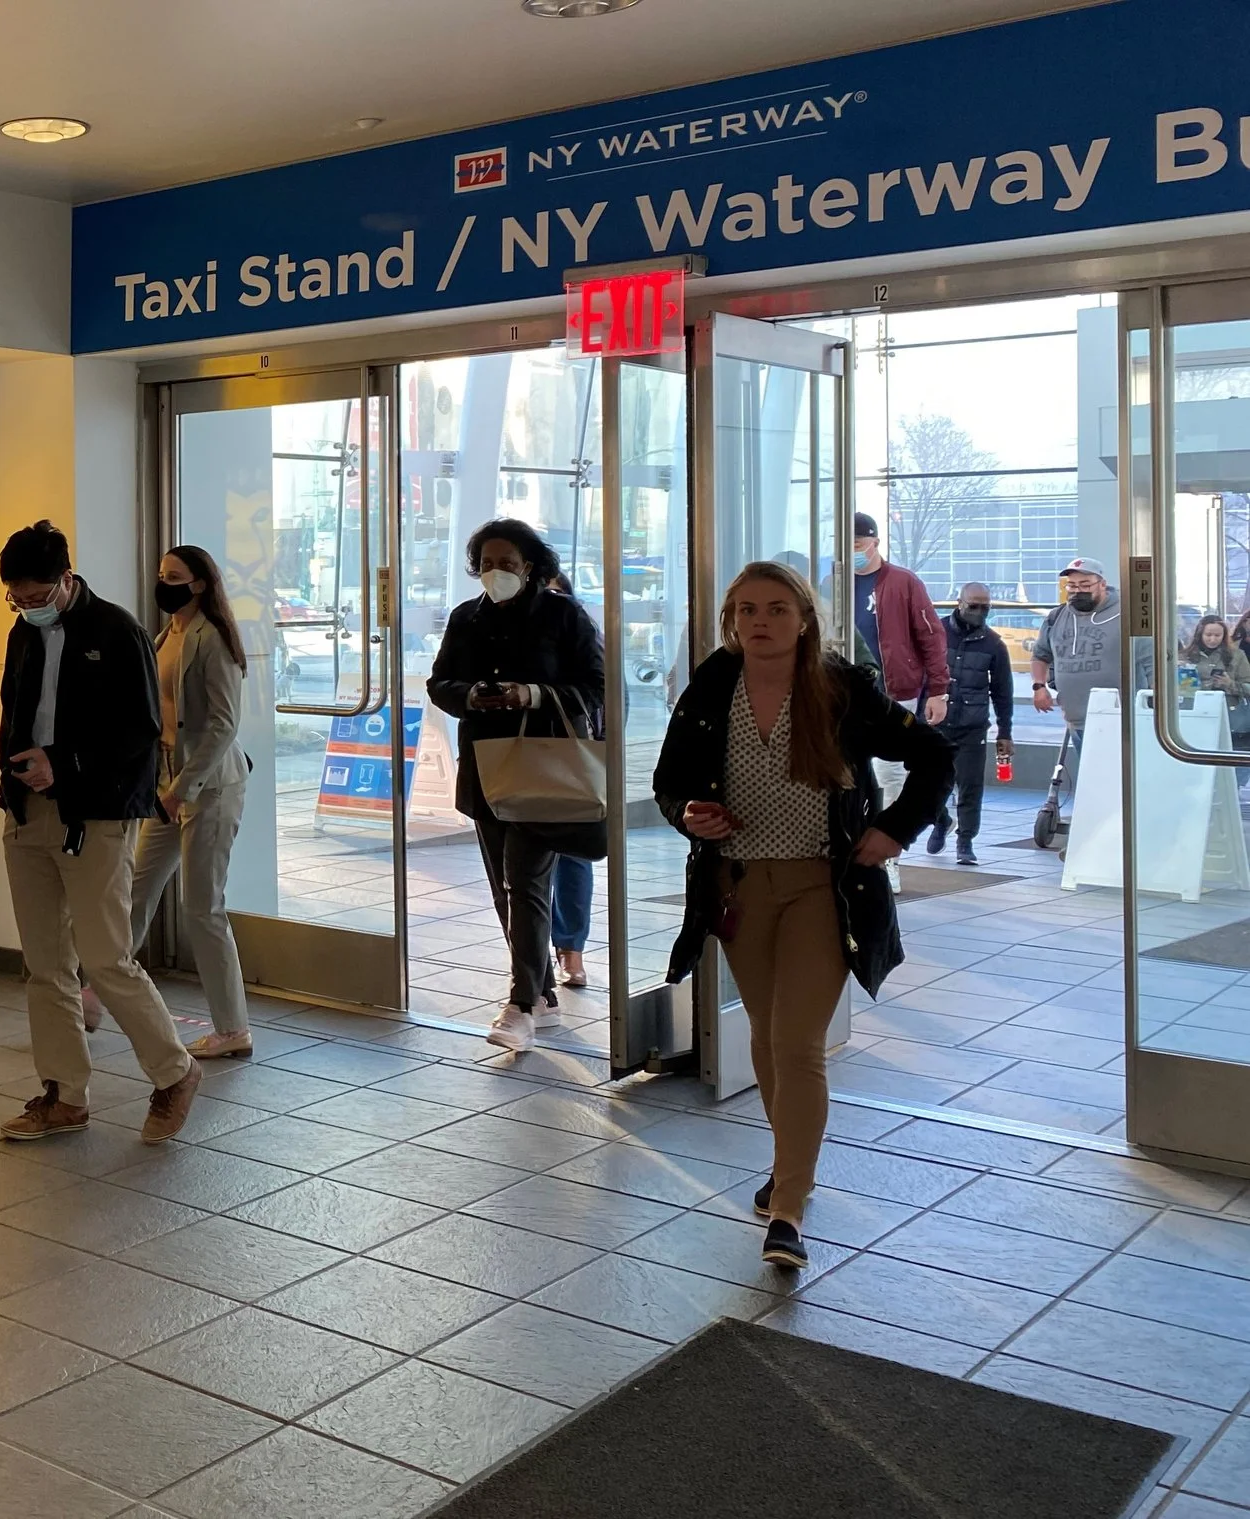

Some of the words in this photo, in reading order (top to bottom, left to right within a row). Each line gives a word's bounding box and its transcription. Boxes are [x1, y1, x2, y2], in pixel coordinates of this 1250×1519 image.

[528, 142, 582, 173] NY
[115, 260, 217, 322] Taxi
[238, 230, 414, 307] Stand
[435, 215, 476, 291] /
[501, 201, 608, 274] NY
[636, 136, 1111, 253] Waterway
[1156, 106, 1250, 184] B
[874, 285, 887, 302] 12
[581, 272, 672, 353] EXIT
[510, 326, 518, 340] 11
[260, 355, 269, 368] 10
[1141, 579, 1149, 629] PUSH
[1057, 660, 1102, 674] CHICAGO
